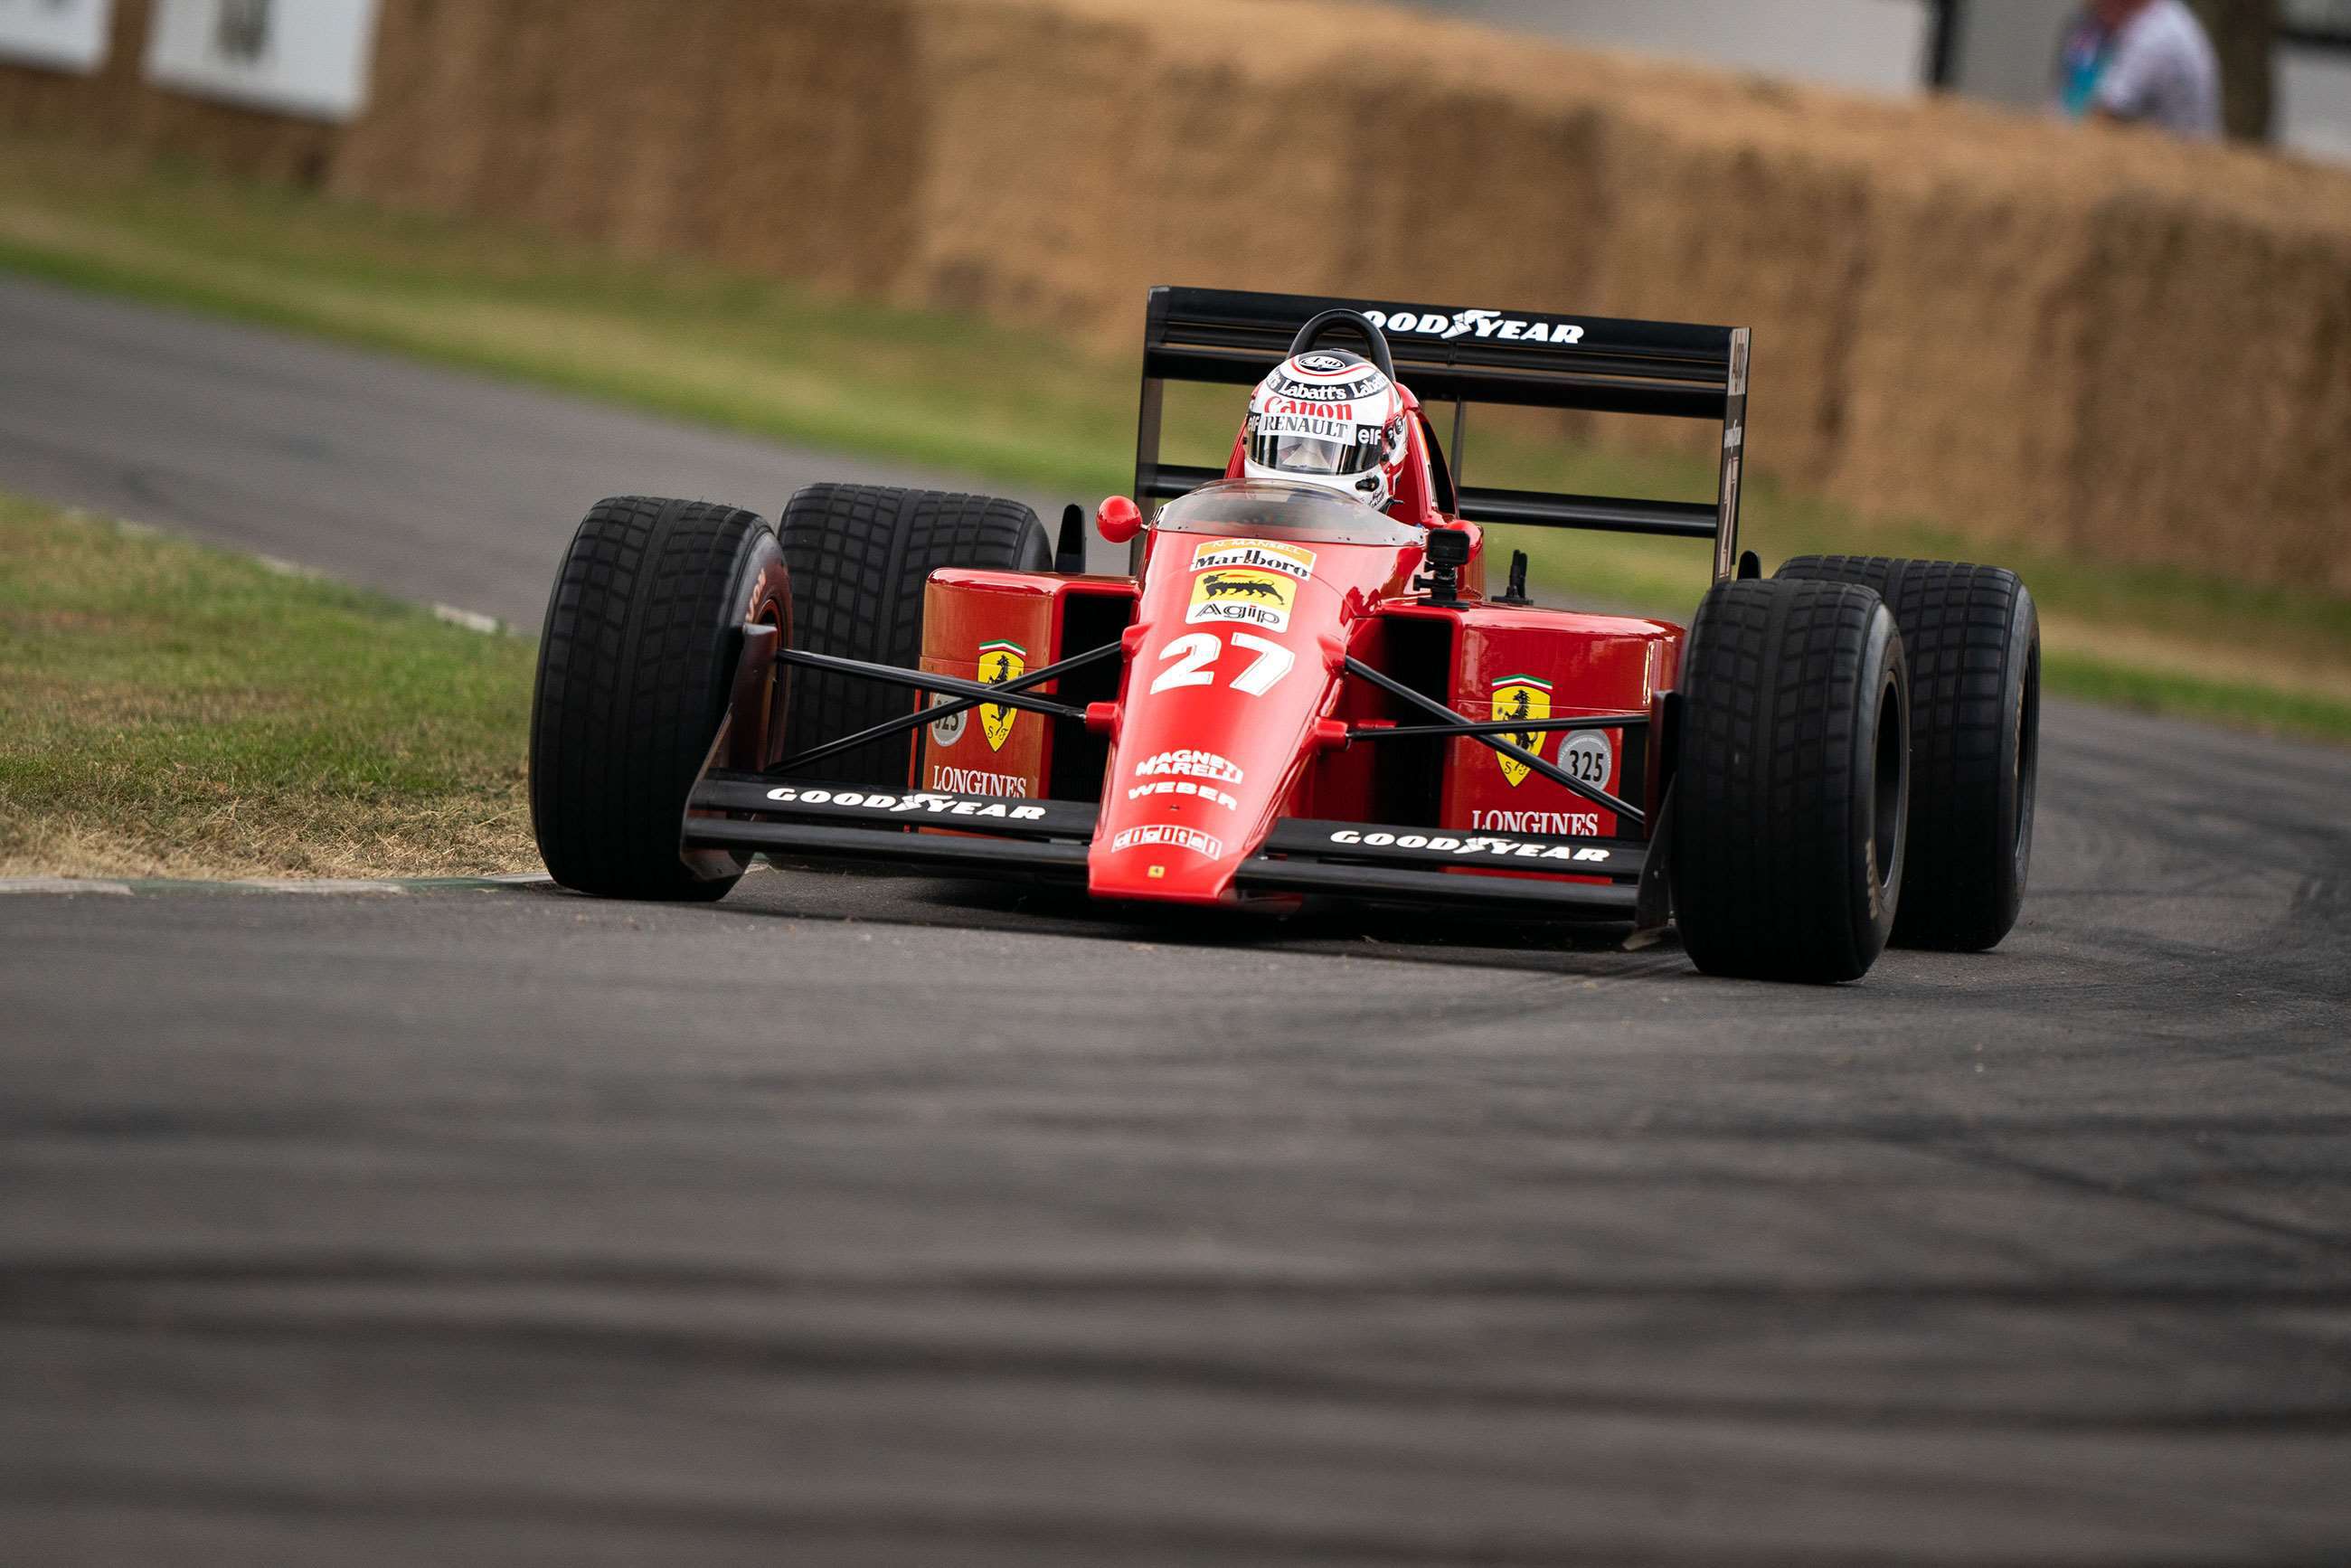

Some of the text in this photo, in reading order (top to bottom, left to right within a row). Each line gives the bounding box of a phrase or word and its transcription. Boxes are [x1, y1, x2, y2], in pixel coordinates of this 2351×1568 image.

[1361, 309, 1584, 344] OODYEAR
[1278, 379, 1347, 400] Labatt's
[1263, 396, 1353, 420] Canon
[1263, 416, 1348, 439] RENAULT
[1357, 428, 1382, 445] elf
[1194, 549, 1308, 577] Marlboro
[1195, 603, 1280, 624] Agip
[1149, 632, 1295, 696] 27
[1569, 750, 1604, 782] 325
[932, 765, 1027, 798] LONGINES
[1128, 781, 1238, 811] WEBER
[767, 788, 1047, 820] GOODYEAR
[1472, 810, 1599, 836] LONGINES
[1330, 830, 1610, 862] GOODYEAR
